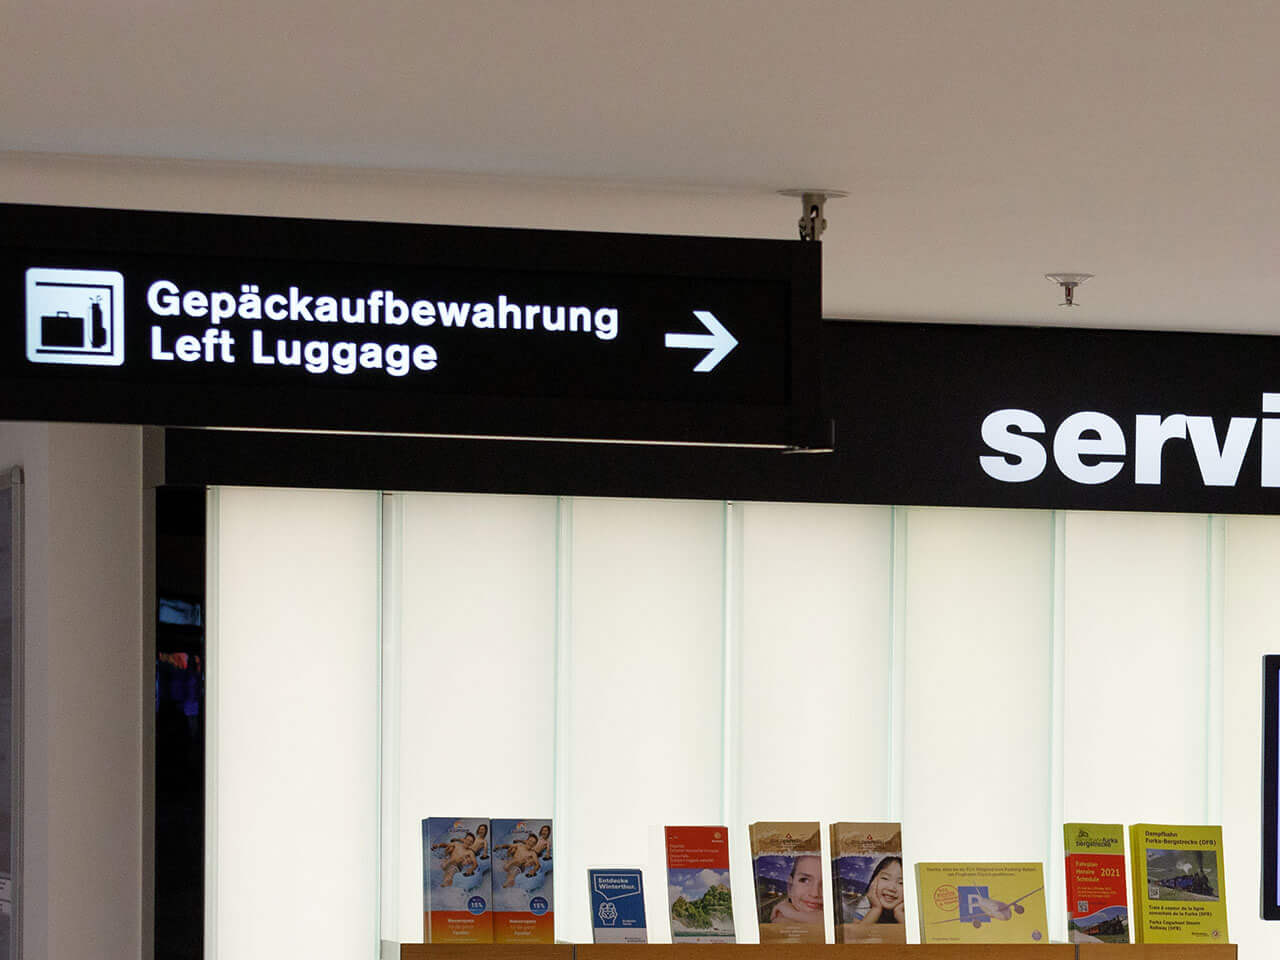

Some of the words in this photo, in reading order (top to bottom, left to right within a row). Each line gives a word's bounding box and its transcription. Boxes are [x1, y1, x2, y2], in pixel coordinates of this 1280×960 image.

[147, 279, 620, 339] Gepäckaufbewahrung
[151, 328, 236, 365] Left
[252, 331, 439, 375] Luggage
[1144, 830, 1179, 839] Dampfbahn
[1145, 838, 1198, 846] Furka-Bergstrecke
[1100, 867, 1121, 878] 2021
